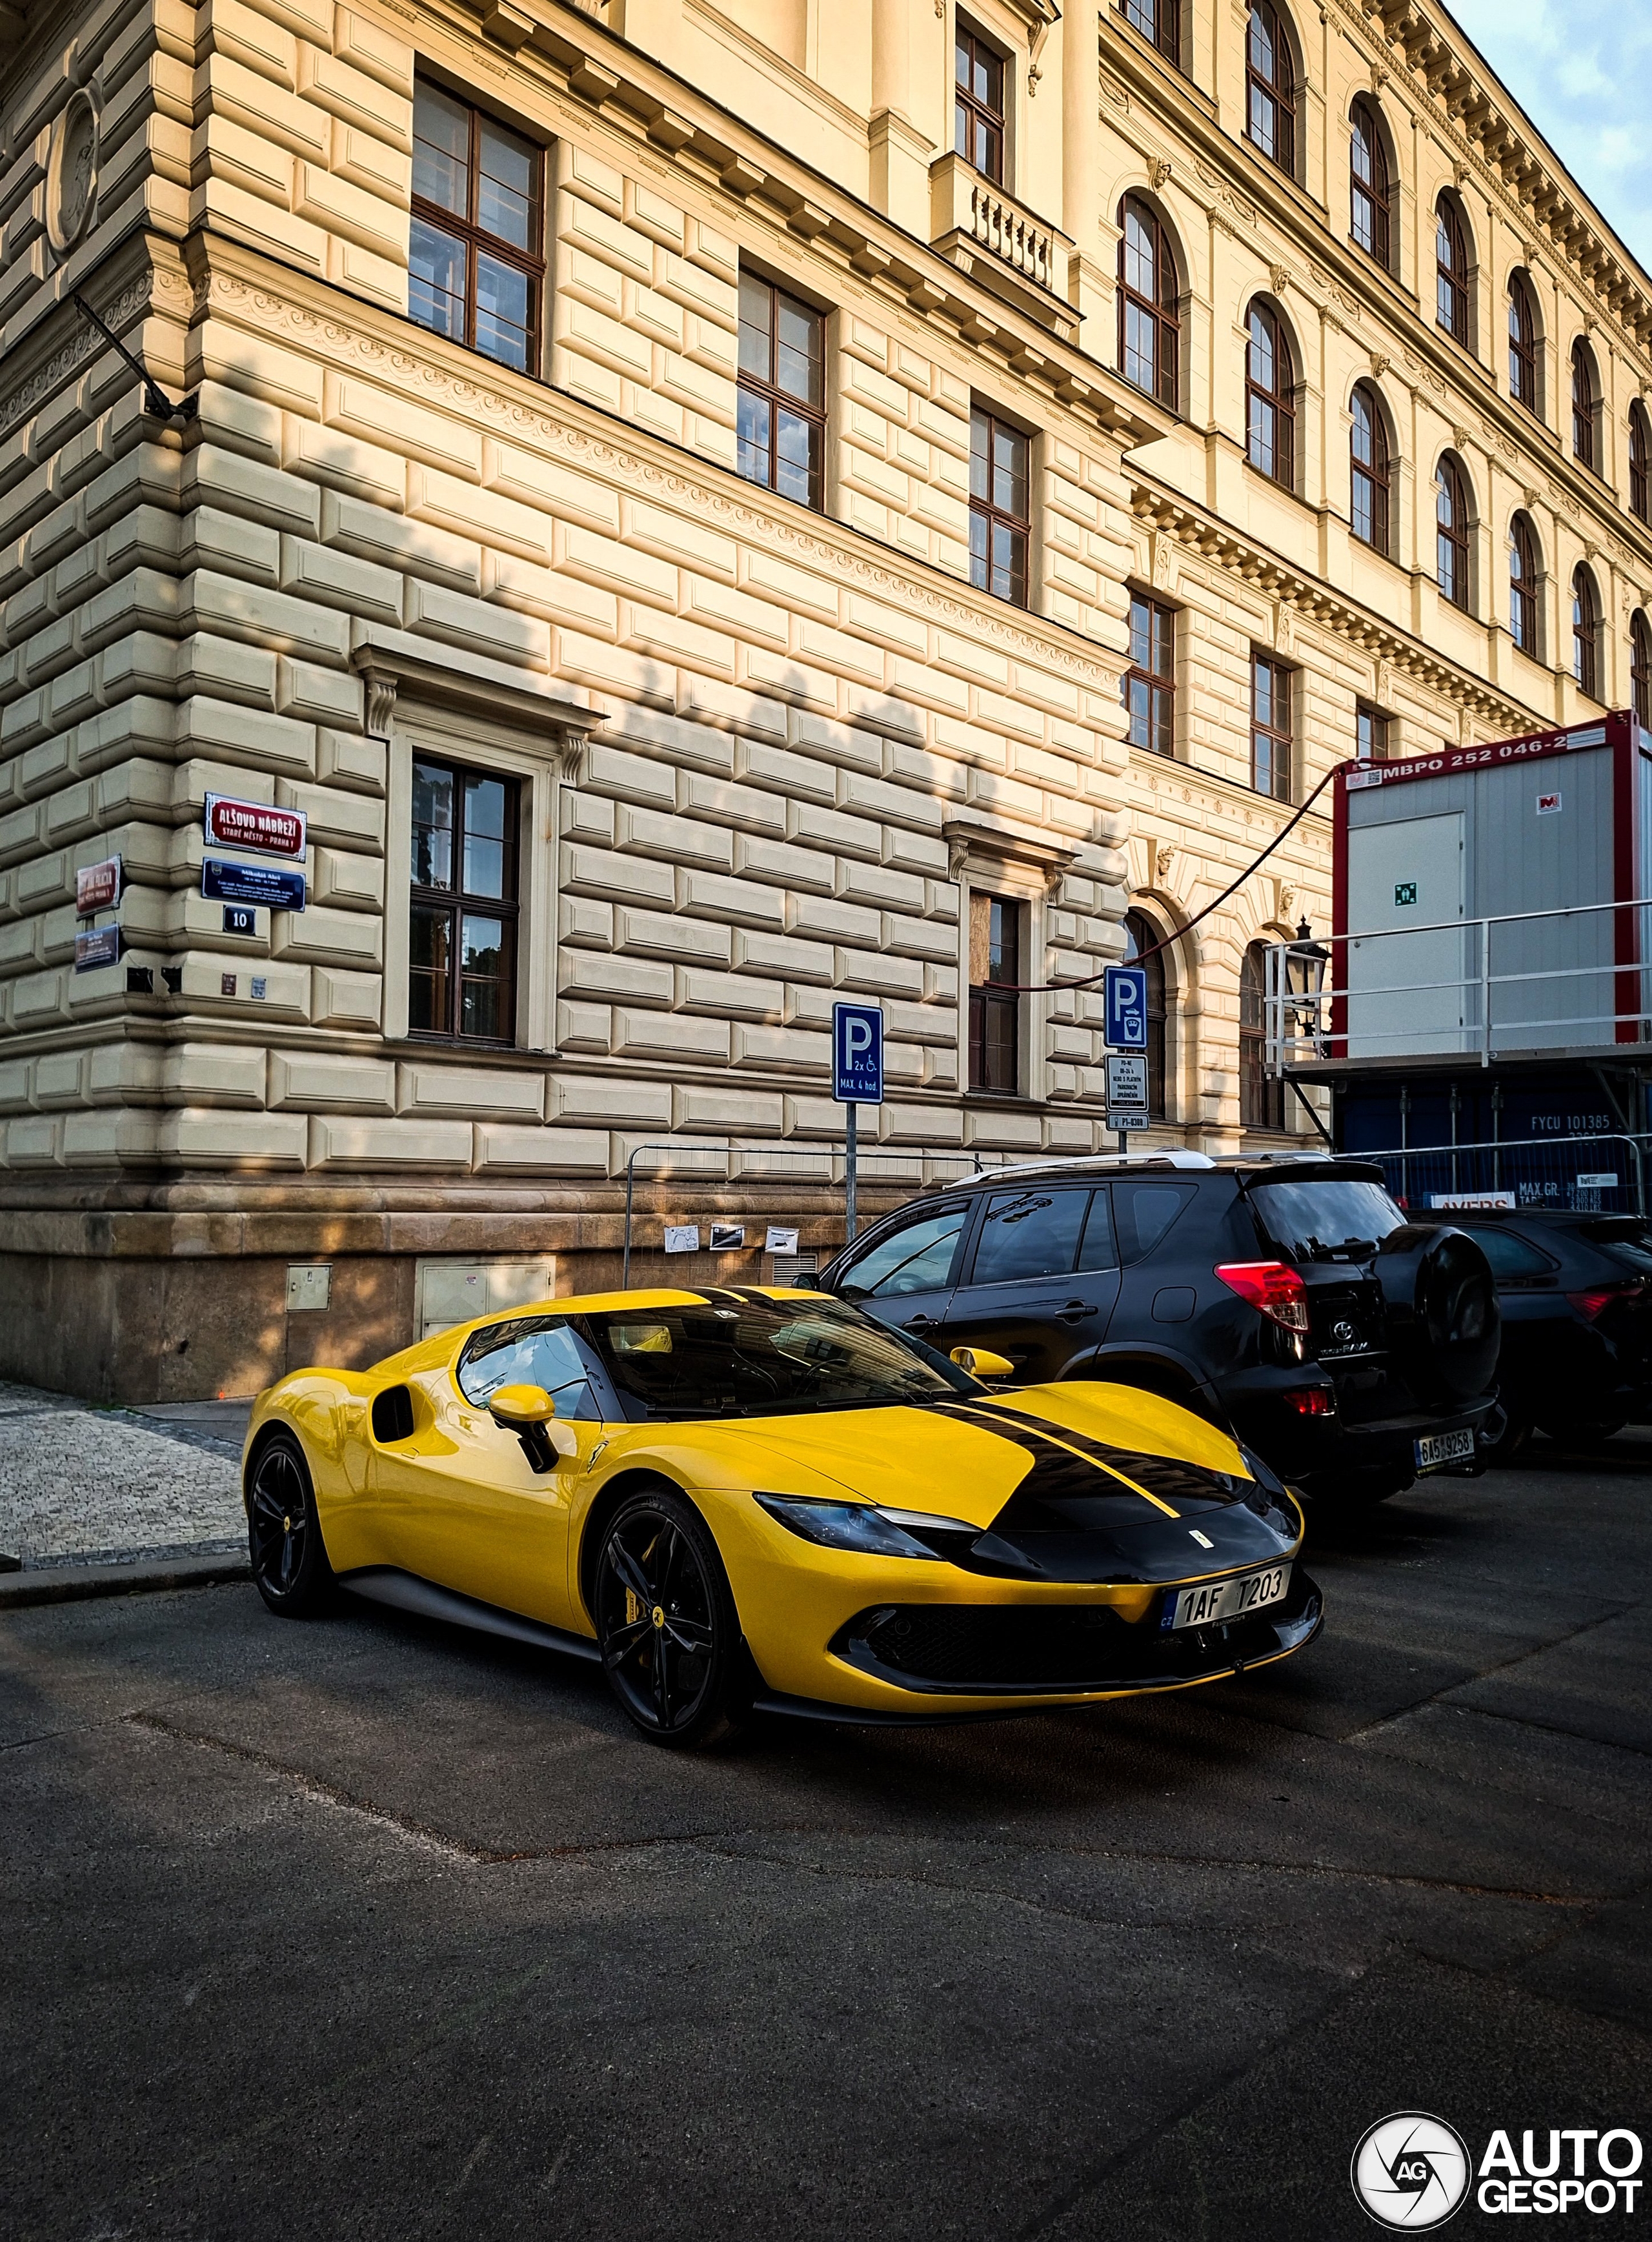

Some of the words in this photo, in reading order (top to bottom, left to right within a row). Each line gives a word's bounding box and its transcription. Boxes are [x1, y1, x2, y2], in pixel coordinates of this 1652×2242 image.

[1384, 759, 1444, 780] MBPO
[1451, 749, 1492, 767] 252
[1499, 736, 1567, 758] 046-2
[219, 807, 256, 829] ALŠOVO
[258, 815, 296, 837] NÁBŘEŽÍ
[222, 827, 241, 838] STARÉ
[243, 830, 264, 842] MĚSTO
[270, 836, 289, 847] PRAHA
[290, 840, 294, 848] 1
[233, 912, 247, 927] 10
[1115, 978, 1137, 1022] P
[846, 1016, 872, 1070] P
[854, 1060, 864, 1071] 2x
[840, 1078, 856, 1089] MAX.
[858, 1080, 863, 1090] 4
[865, 1080, 878, 1091] hod.
[1532, 1116, 1560, 1130] FYCU
[1567, 1115, 1610, 1129] 101385
[1519, 1182, 1544, 1196] MAX.
[1545, 1182, 1560, 1196] GR.
[1422, 1439, 1440, 1462] 6A5
[1446, 1431, 1469, 1457] 9258
[1184, 1586, 1224, 1623] 1AF
[1238, 1569, 1282, 1610] T203
[1161, 1616, 1173, 1627] CZ
